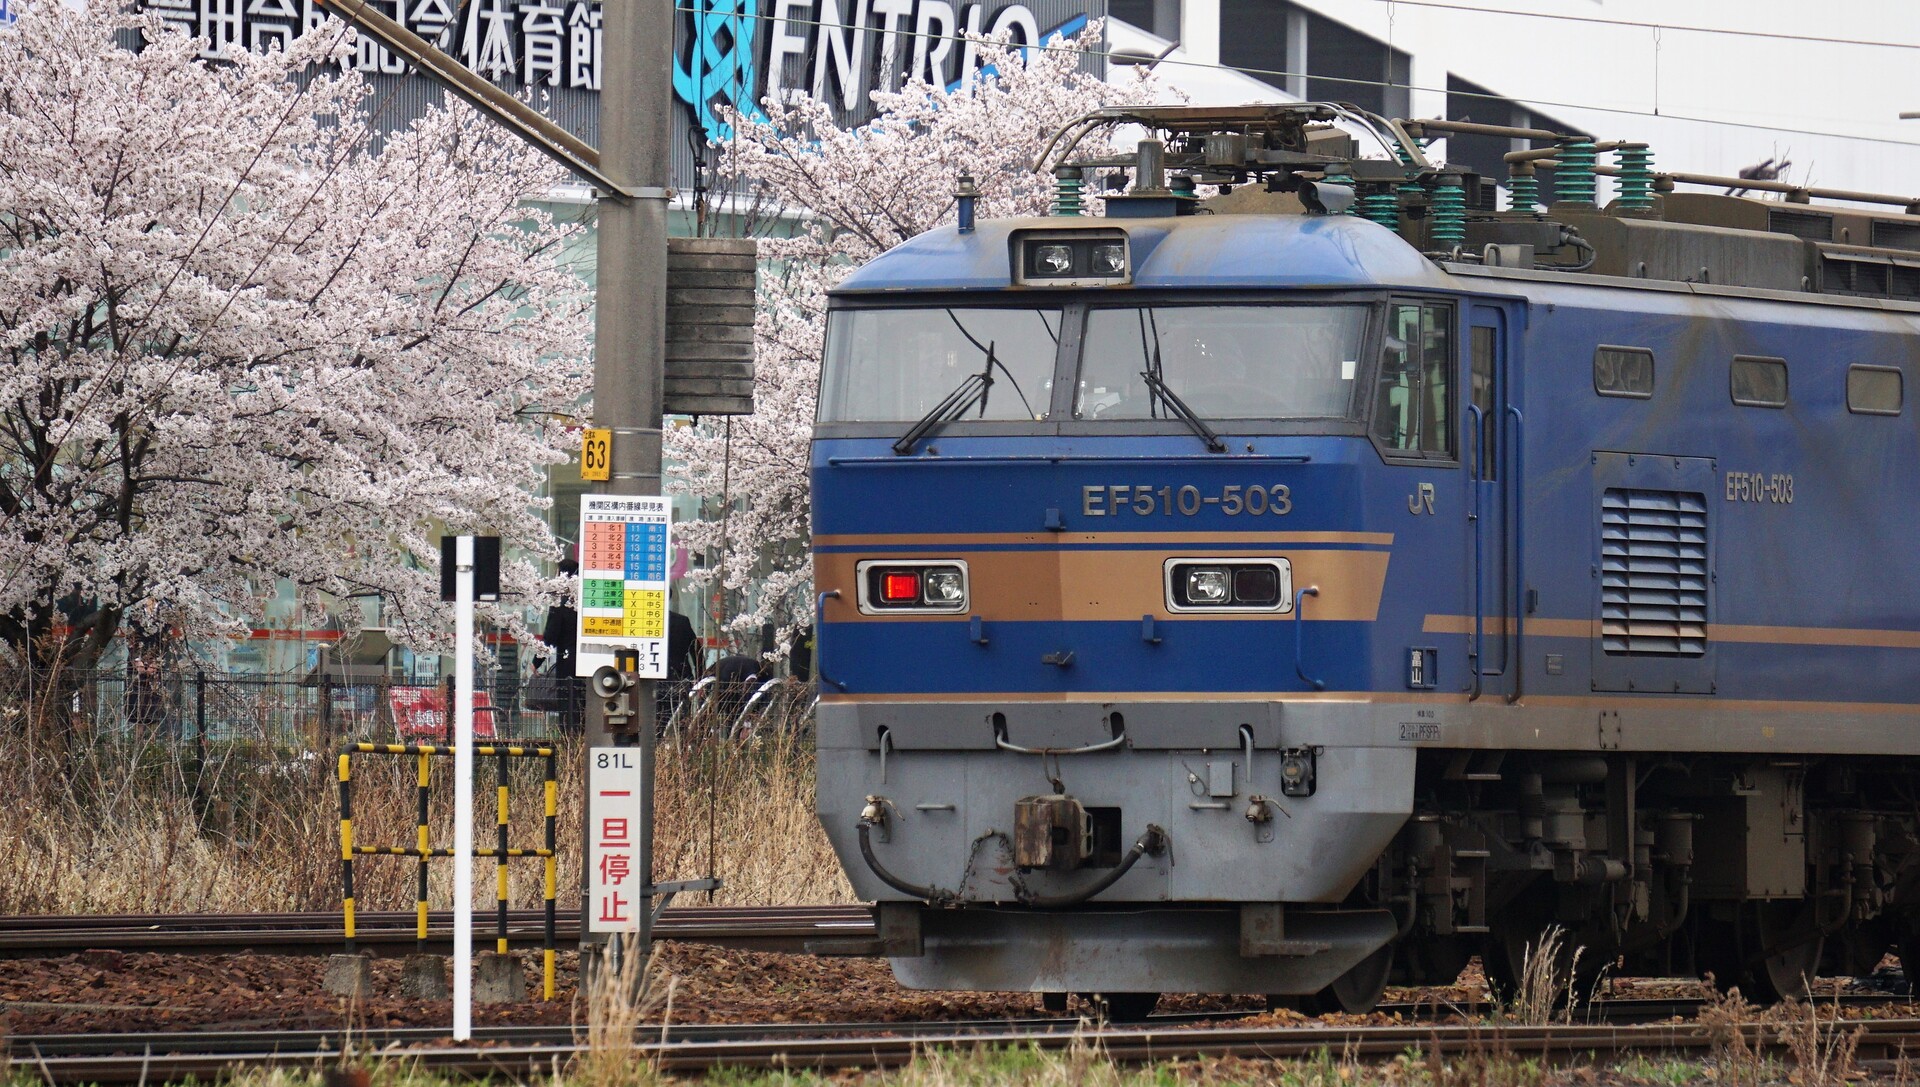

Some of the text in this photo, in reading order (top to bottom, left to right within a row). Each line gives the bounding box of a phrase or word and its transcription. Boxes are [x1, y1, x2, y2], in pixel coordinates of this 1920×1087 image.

[765, 0, 1040, 112] ENTRIO
[586, 440, 605, 468] 63
[1082, 484, 1293, 516] EF510-503
[1408, 482, 1435, 516] JR
[1726, 471, 1794, 504] EF510-503
[630, 572, 639, 580] 16
[1412, 650, 1422, 684] 富山
[1401, 725, 1406, 738] 2
[597, 753, 633, 768] 81L
[599, 791, 631, 922] 一旦停止
